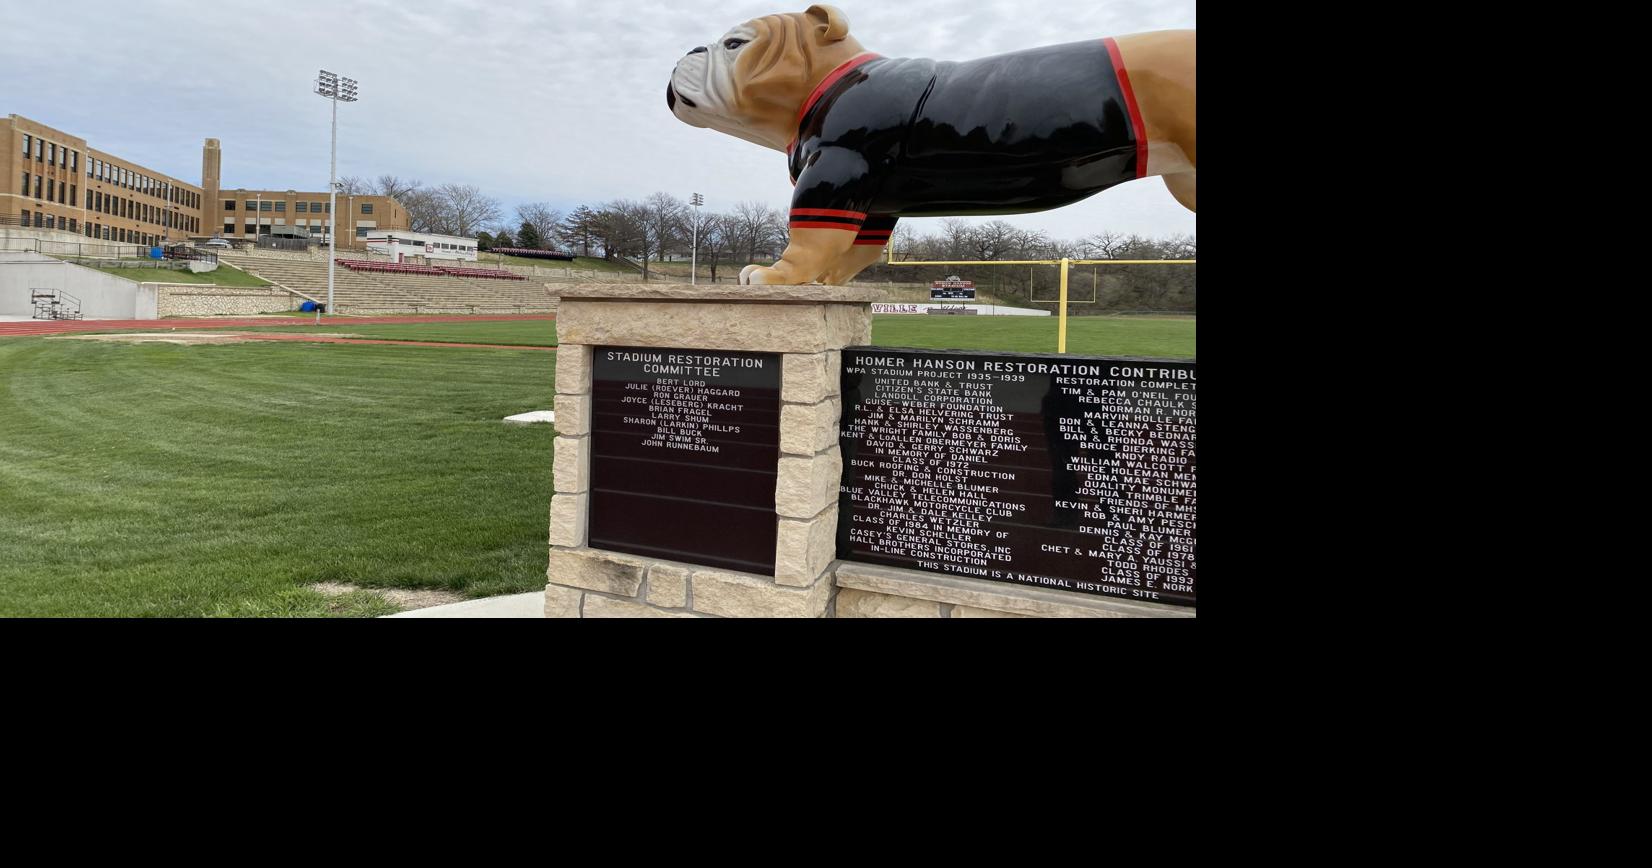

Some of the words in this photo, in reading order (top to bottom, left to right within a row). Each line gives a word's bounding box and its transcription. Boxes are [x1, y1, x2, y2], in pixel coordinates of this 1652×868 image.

[608, 352, 662, 363] STADIUM
[668, 354, 763, 368] RESTORATION
[856, 356, 904, 368] HOMER
[913, 358, 975, 370] HANSON
[984, 361, 1100, 375] RESTORATION
[644, 364, 720, 376] COMMITTEE
[871, 368, 913, 376] STADIUM
[918, 370, 963, 379] PROJECT
[652, 385, 694, 394] (ROEVER)
[698, 387, 740, 396] HAGGARD
[674, 393, 708, 401] GRAUER
[875, 392, 919, 401] LANDOLL
[924, 394, 993, 405] CORPORATION
[876, 385, 922, 394] CITIZEN'S
[928, 388, 959, 396] STATE
[621, 396, 647, 404] JOYCE
[651, 398, 704, 408] (LESEBERG)
[707, 402, 744, 411] KRACHT
[649, 405, 674, 413] BRIAN
[678, 407, 712, 416] FRAGEL
[940, 403, 1003, 412] FOUNDATION
[652, 412, 681, 421] LARRY
[685, 415, 709, 423] SHUM
[901, 414, 944, 424] MARILYN
[949, 417, 1000, 427] SCHRAMM
[919, 408, 974, 418] HELVERING
[979, 412, 1014, 420] TRUST
[624, 417, 656, 426] SHARON
[660, 420, 699, 429] (LARKIN)
[702, 423, 740, 433] PHILLPS
[680, 428, 702, 436] BUCK
[897, 421, 939, 430] SHIRLEY
[944, 424, 1014, 435] WASSENBERG
[669, 435, 691, 443] SWIM
[871, 426, 907, 435] WRIGHT
[912, 429, 947, 438] FAMILY
[991, 435, 1021, 443] DORIS
[641, 439, 663, 448] JOHN
[666, 442, 719, 452] RUNNEBAUM
[866, 440, 894, 448] DAVID
[912, 443, 944, 452] GERRY
[949, 446, 999, 456] SCHWARZ
[926, 437, 987, 448] OBERMEYER
[991, 442, 1028, 451] FAMILY
[888, 448, 929, 458] MEMORY
[951, 454, 988, 463] DANIEL
[892, 456, 925, 465] CLASS
[947, 460, 969, 468] 1972
[851, 460, 874, 468] BUCK
[880, 462, 919, 472] ROOFING
[937, 467, 1015, 480] CONSTRUCTION
[912, 472, 931, 480] DON
[935, 474, 968, 483] HOLST
[865, 475, 886, 483] MIKE
[904, 478, 952, 489] MICHELLE
[957, 483, 999, 493] BLUMER
[875, 482, 905, 492] CHUCK
[923, 487, 955, 496] HELEN
[959, 491, 987, 500] HALL
[841, 486, 863, 495] BLUE
[868, 489, 906, 499] VALLEY
[911, 493, 1026, 510] TELECOMMUNICATIONS
[851, 494, 909, 506] BLACKHAWK
[914, 500, 981, 514] MOTORCYCLE
[986, 508, 1012, 517] CLUB
[868, 503, 882, 511] DR.
[887, 505, 904, 513] JIM
[921, 508, 947, 517] DALE
[952, 511, 992, 522] KELLEY
[880, 511, 924, 522] CHARLES
[930, 516, 979, 528] WETZLER
[853, 515, 884, 525] CLASS
[905, 520, 928, 530] 1984
[947, 525, 990, 536] MEMORY
[1107, 521, 1136, 531] PAUL
[1142, 525, 1191, 536] BLUMER
[850, 528, 892, 540] CASEY'S
[896, 534, 942, 546] GENERAL
[995, 545, 1011, 554] INC
[886, 526, 915, 535] KEVIN
[920, 529, 971, 542] SCHELLER
[850, 535, 874, 545] HALL
[879, 539, 930, 551] BROTHERS
[935, 545, 1012, 561] INCORPORATED
[1104, 536, 1143, 547] CLASS
[1149, 541, 1164, 549] OF
[1170, 543, 1193, 552] 1961
[871, 545, 906, 556] IN-LINE
[910, 550, 987, 566] CONSTRUCTION
[1102, 544, 1141, 555] CLASS
[1147, 549, 1162, 557] OF
[1168, 551, 1195, 561] 1978
[1101, 567, 1140, 578] CLASS
[1146, 572, 1161, 581] OF
[1167, 575, 1194, 585] 1993
[1108, 560, 1137, 570] TODD
[1143, 564, 1189, 576] RHODES
[917, 560, 939, 570] THIS
[944, 564, 988, 576] STADIUM
[992, 570, 1001, 578] IS
[1018, 574, 1071, 588] NATIONAL
[1077, 581, 1127, 595] HISTORIC
[1133, 589, 1159, 599] SITE
[1101, 575, 1141, 586] JAMES
[1163, 582, 1193, 592] NORK
